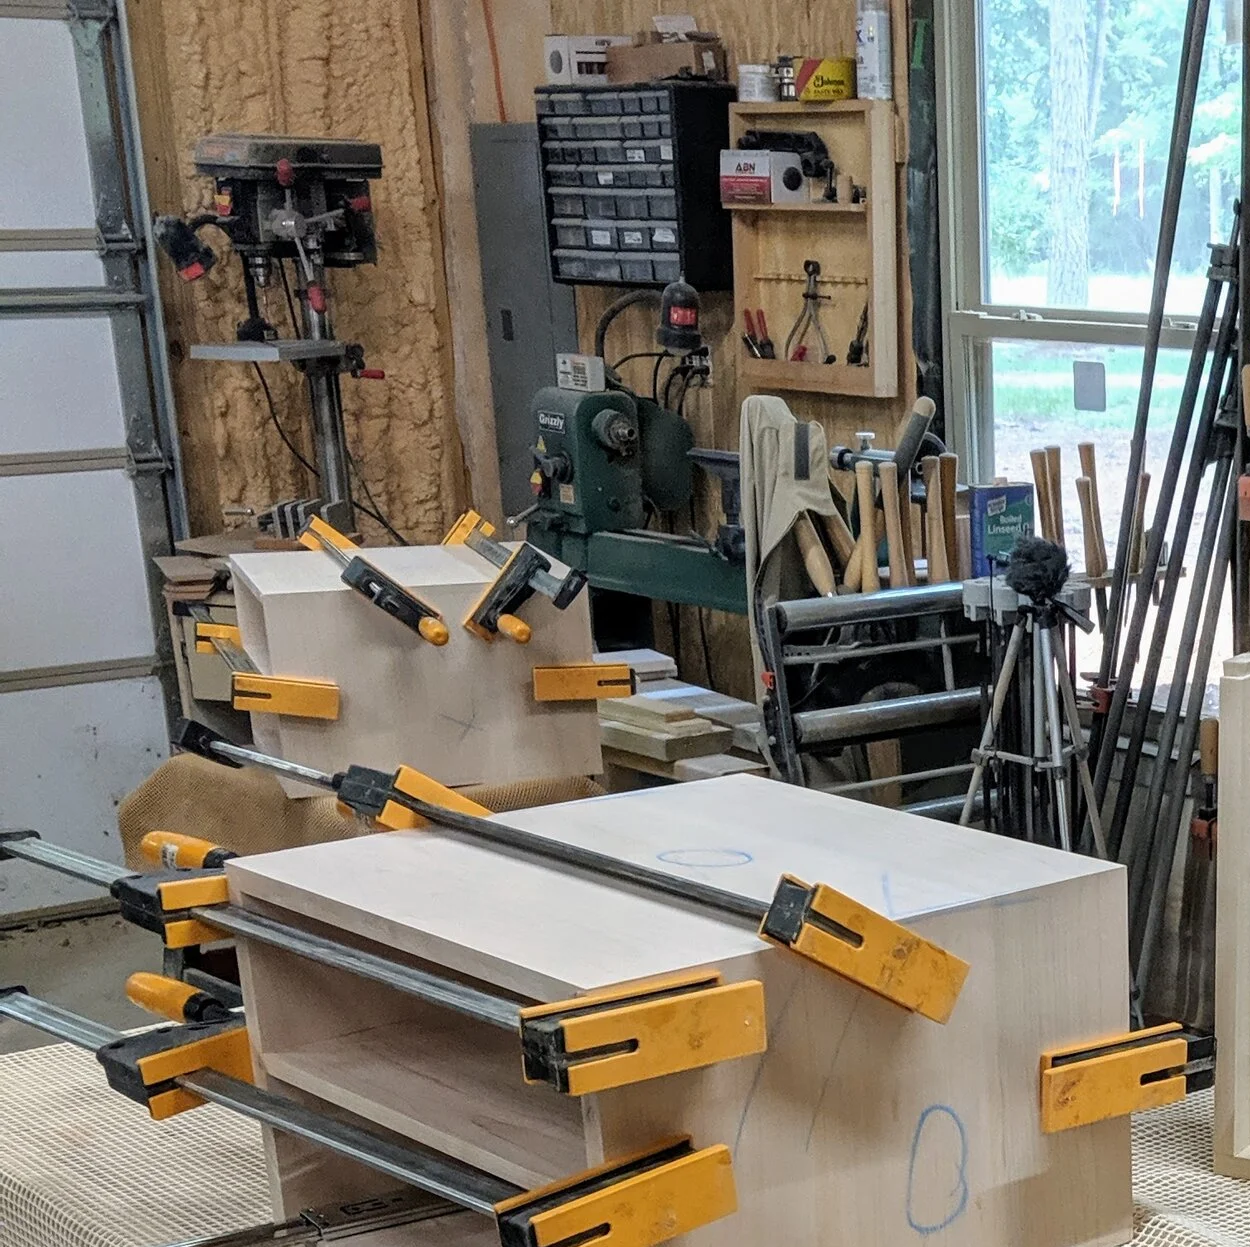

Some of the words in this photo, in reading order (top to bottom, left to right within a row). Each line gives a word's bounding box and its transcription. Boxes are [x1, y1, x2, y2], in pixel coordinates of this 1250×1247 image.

[736, 162, 756, 172] ABN
[539, 413, 564, 429] Grizzly
[988, 522, 1021, 535] Linseed
